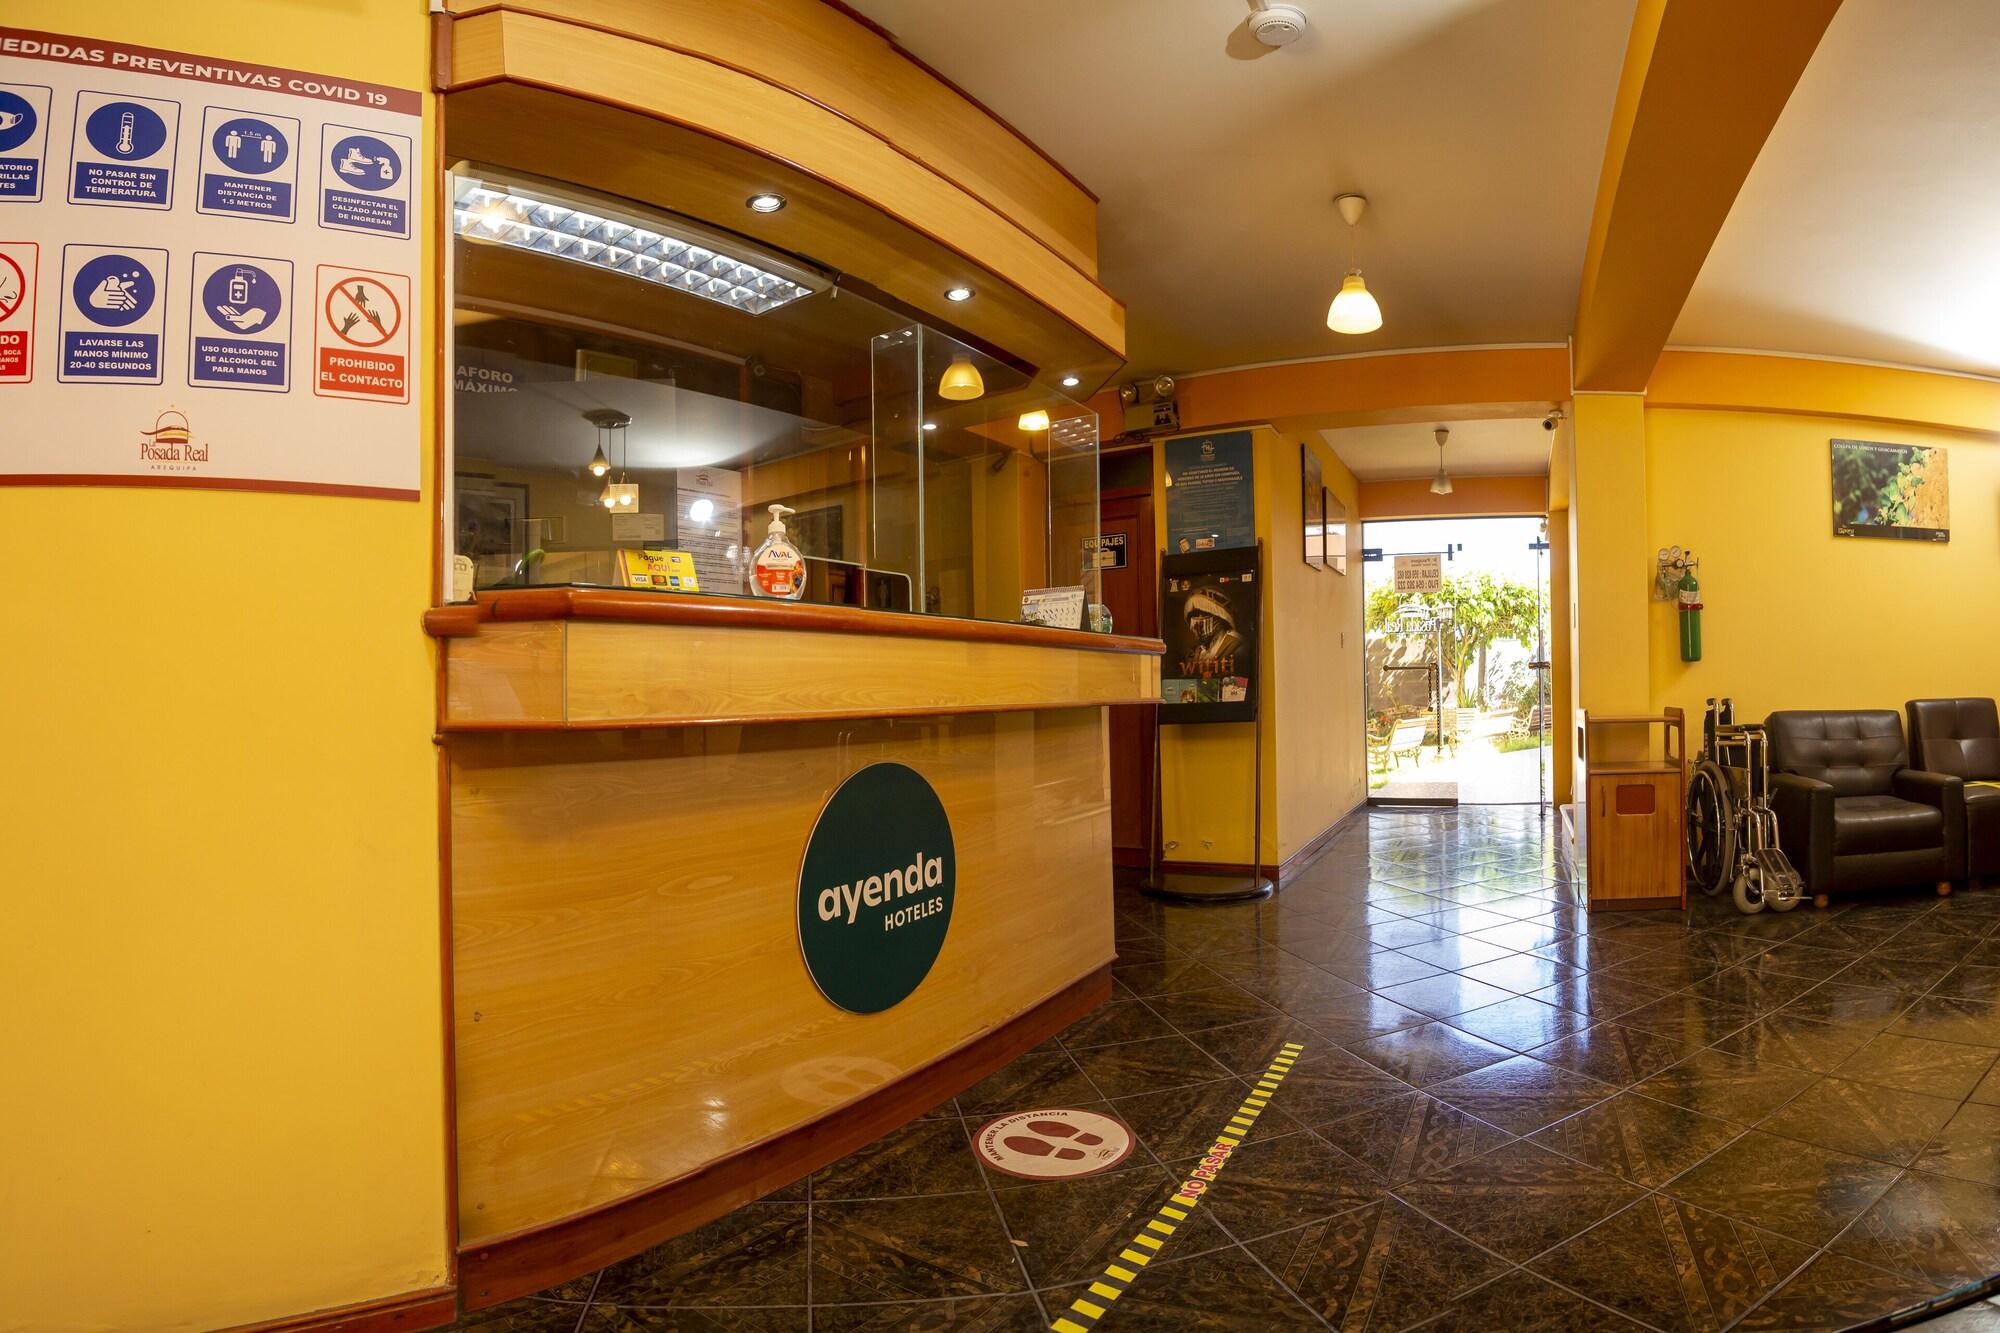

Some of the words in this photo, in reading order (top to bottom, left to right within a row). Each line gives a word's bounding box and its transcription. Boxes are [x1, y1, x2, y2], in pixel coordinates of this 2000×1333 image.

[0, 37, 105, 62] EDIDAS
[112, 52, 281, 88] PREVENTIVAS
[288, 79, 360, 100] COVID
[366, 91, 387, 106] 19
[106, 170, 137, 179] PASAR
[91, 178, 136, 188] CONTROL
[224, 182, 272, 192] MANTENER
[85, 186, 156, 197] TEMPERATURA
[217, 189, 263, 201] DISTANCIA
[236, 200, 272, 209] METROS
[332, 196, 386, 210] DESINFECTAR
[332, 204, 370, 214] CALZADO
[372, 210, 398, 219] ANTES
[351, 215, 392, 226] INGRESAR
[80, 339, 122, 347] LAVARSE
[74, 350, 109, 358] MANOS
[115, 350, 149, 359] MÍNIMO
[222, 346, 279, 357] OBLIGATORIO
[98, 362, 152, 370] SEGUNDOS
[218, 357, 259, 366] ALCOHOL
[261, 359, 278, 367] GEL
[330, 357, 395, 372] PROHIBIDO
[237, 367, 267, 376] MANOS
[456, 365, 513, 383] AFORO
[321, 372, 335, 381] EL
[339, 374, 403, 388] CONTACTO
[141, 442, 180, 460] Posada
[184, 443, 208, 462] Real
[1084, 537, 1124, 549] EQUPAJES
[768, 550, 792, 558] AVAL
[817, 852, 942, 925] ayenda
[885, 897, 943, 932] HOTELES
[985, 1130, 1005, 1161] MANTENER
[997, 1122, 1009, 1130] LA
[1008, 1112, 1069, 1124] DISTANCIA
[1178, 1180, 1207, 1200] NO
[1194, 1143, 1234, 1179] PASAR
